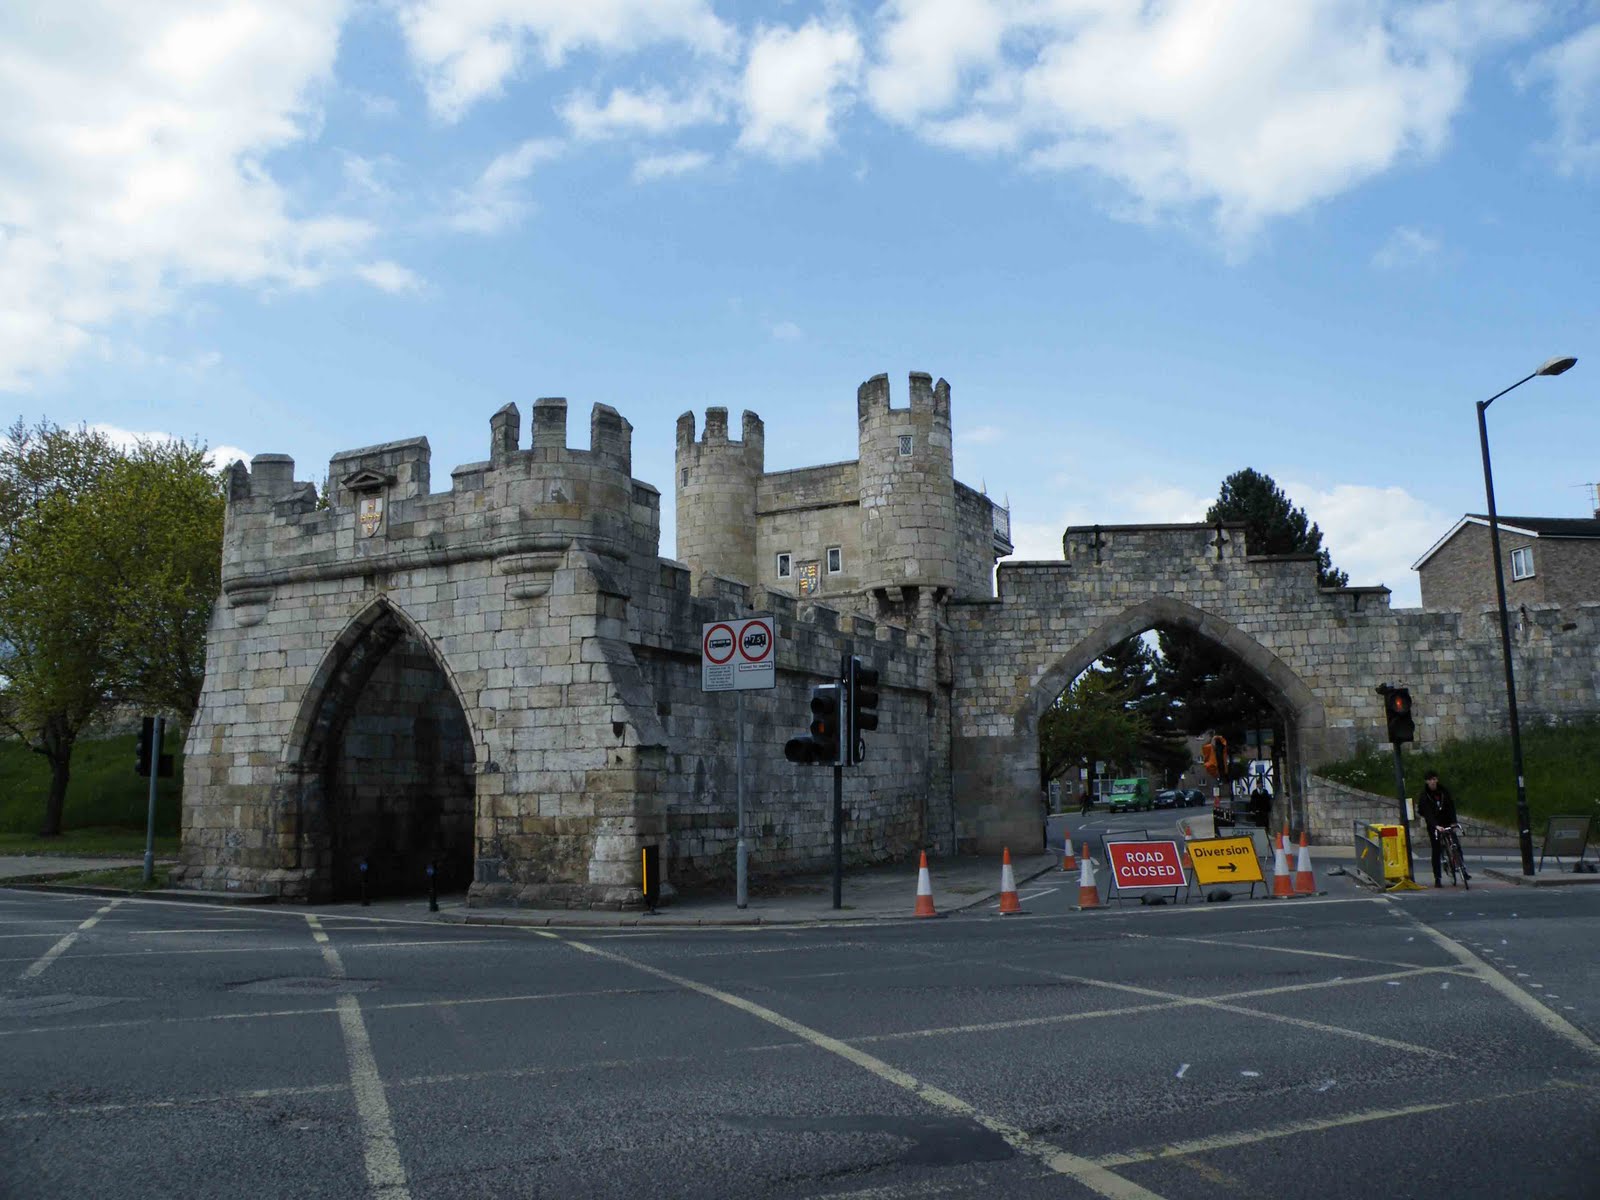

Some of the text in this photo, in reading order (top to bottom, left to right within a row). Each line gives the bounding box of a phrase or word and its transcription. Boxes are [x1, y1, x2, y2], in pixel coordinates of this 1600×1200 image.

[1125, 852, 1164, 863] ROAD
[1193, 845, 1250, 858] Diversion
[1121, 865, 1176, 877] CLOSED
